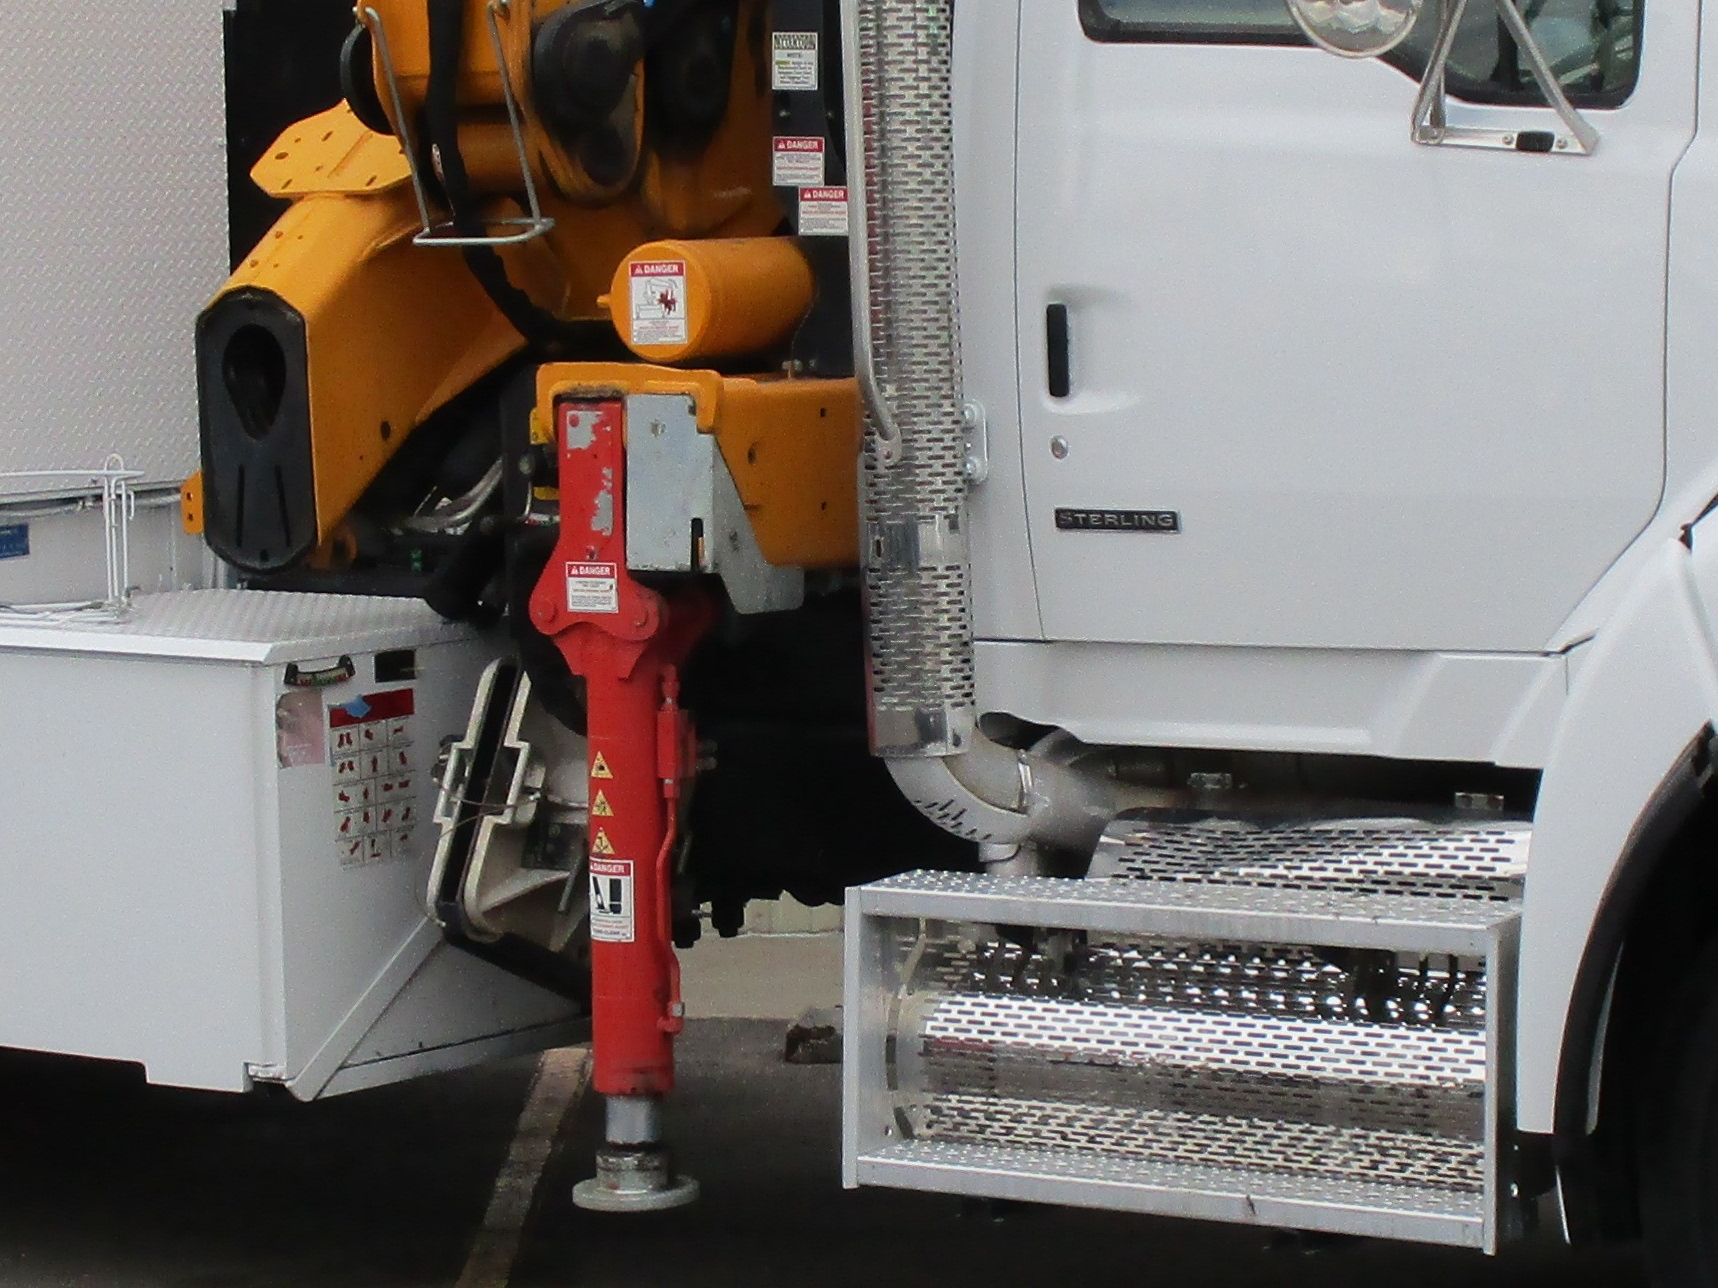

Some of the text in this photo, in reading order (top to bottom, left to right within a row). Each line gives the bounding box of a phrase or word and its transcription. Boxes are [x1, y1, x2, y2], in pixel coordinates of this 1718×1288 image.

[786, 139, 819, 150] DANGER
[812, 189, 845, 200] DANGER
[643, 263, 679, 274] DANGER
[1059, 512, 1173, 527] STERLING
[579, 566, 610, 575] DANGER
[593, 863, 625, 873] DANGER
